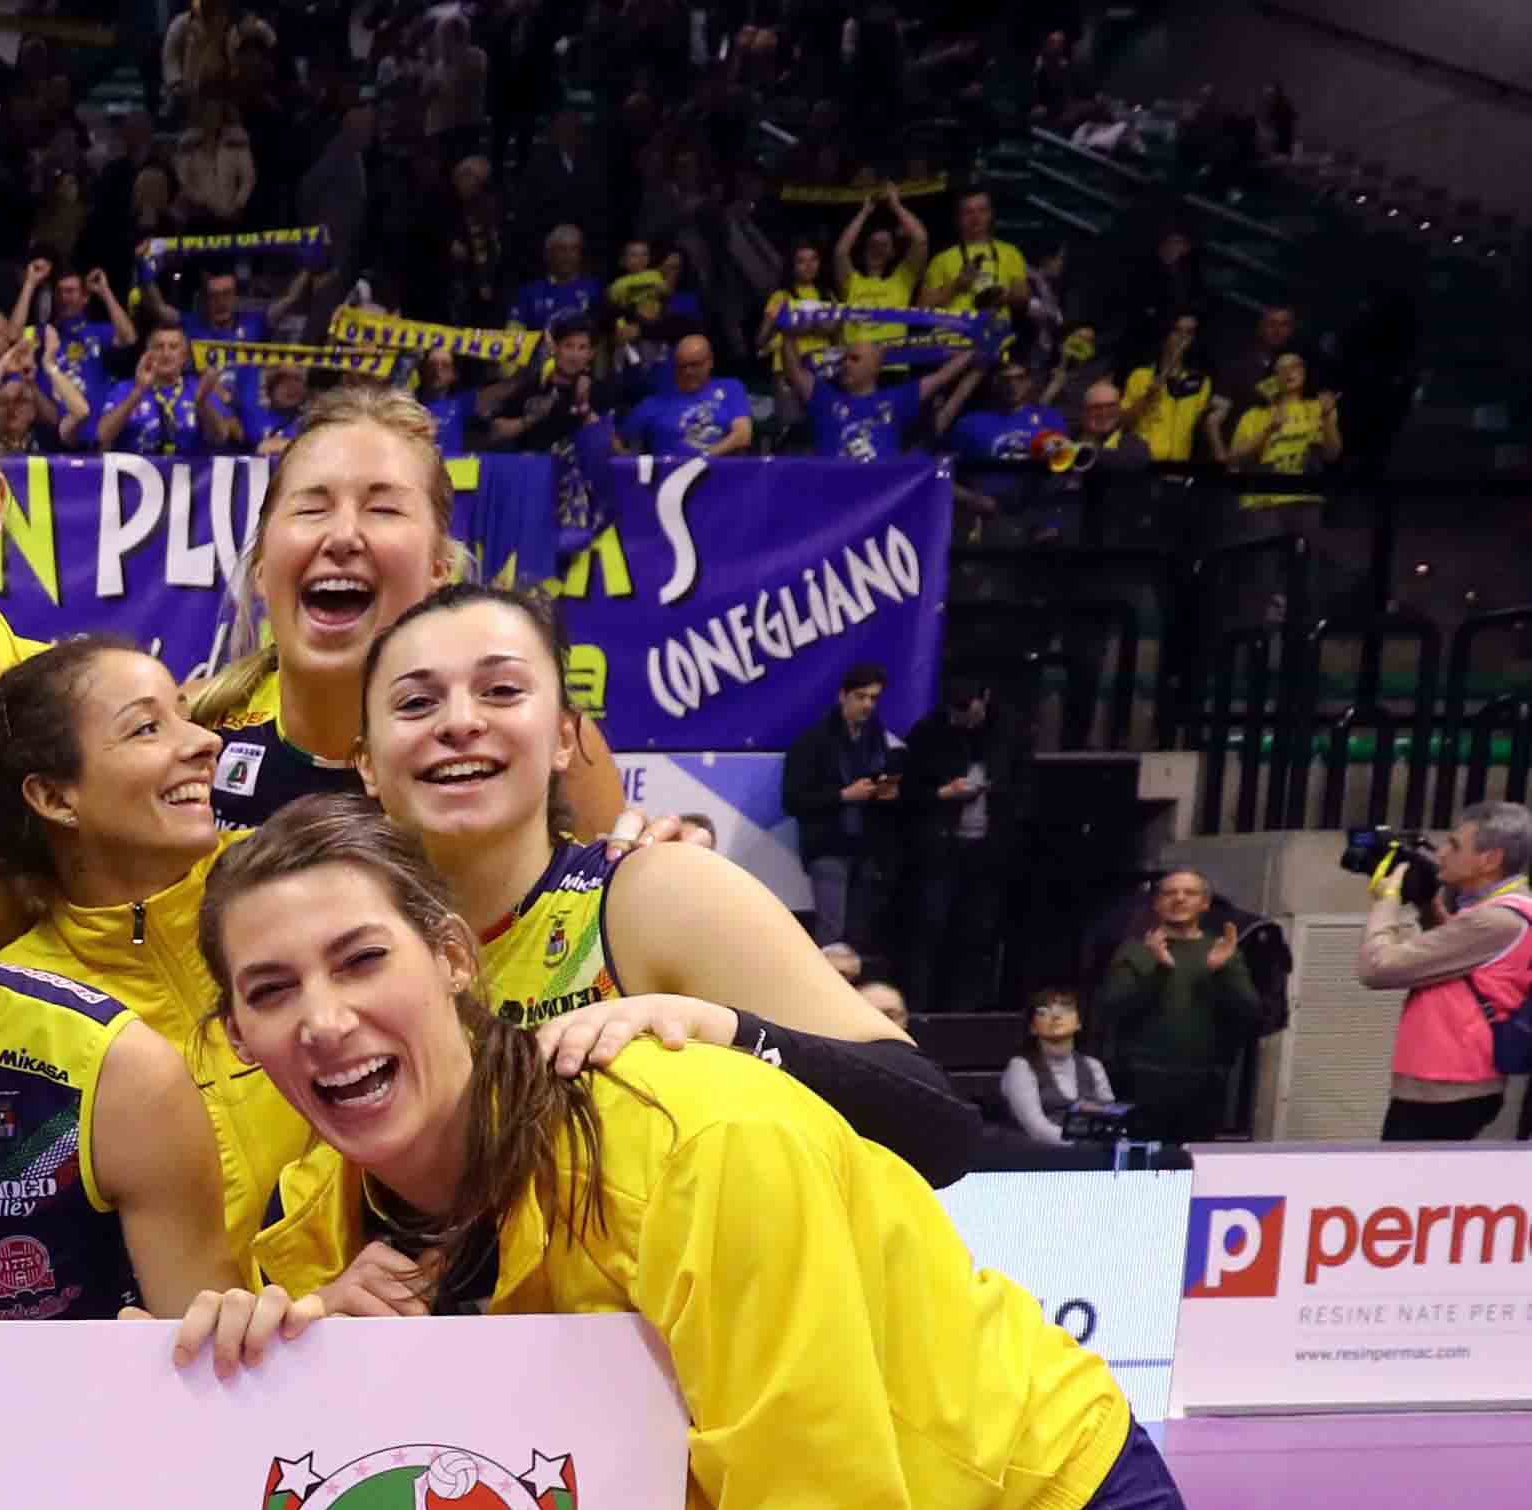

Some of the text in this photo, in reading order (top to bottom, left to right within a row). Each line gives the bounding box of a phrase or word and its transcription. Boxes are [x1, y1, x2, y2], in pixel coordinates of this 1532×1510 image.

[95, 453, 270, 599] PLU
[1303, 1202, 1532, 1285] perm
[1298, 1303, 1517, 1324] RESINE NATE PER
[1294, 1344, 1472, 1362] www.resinpermac.com
